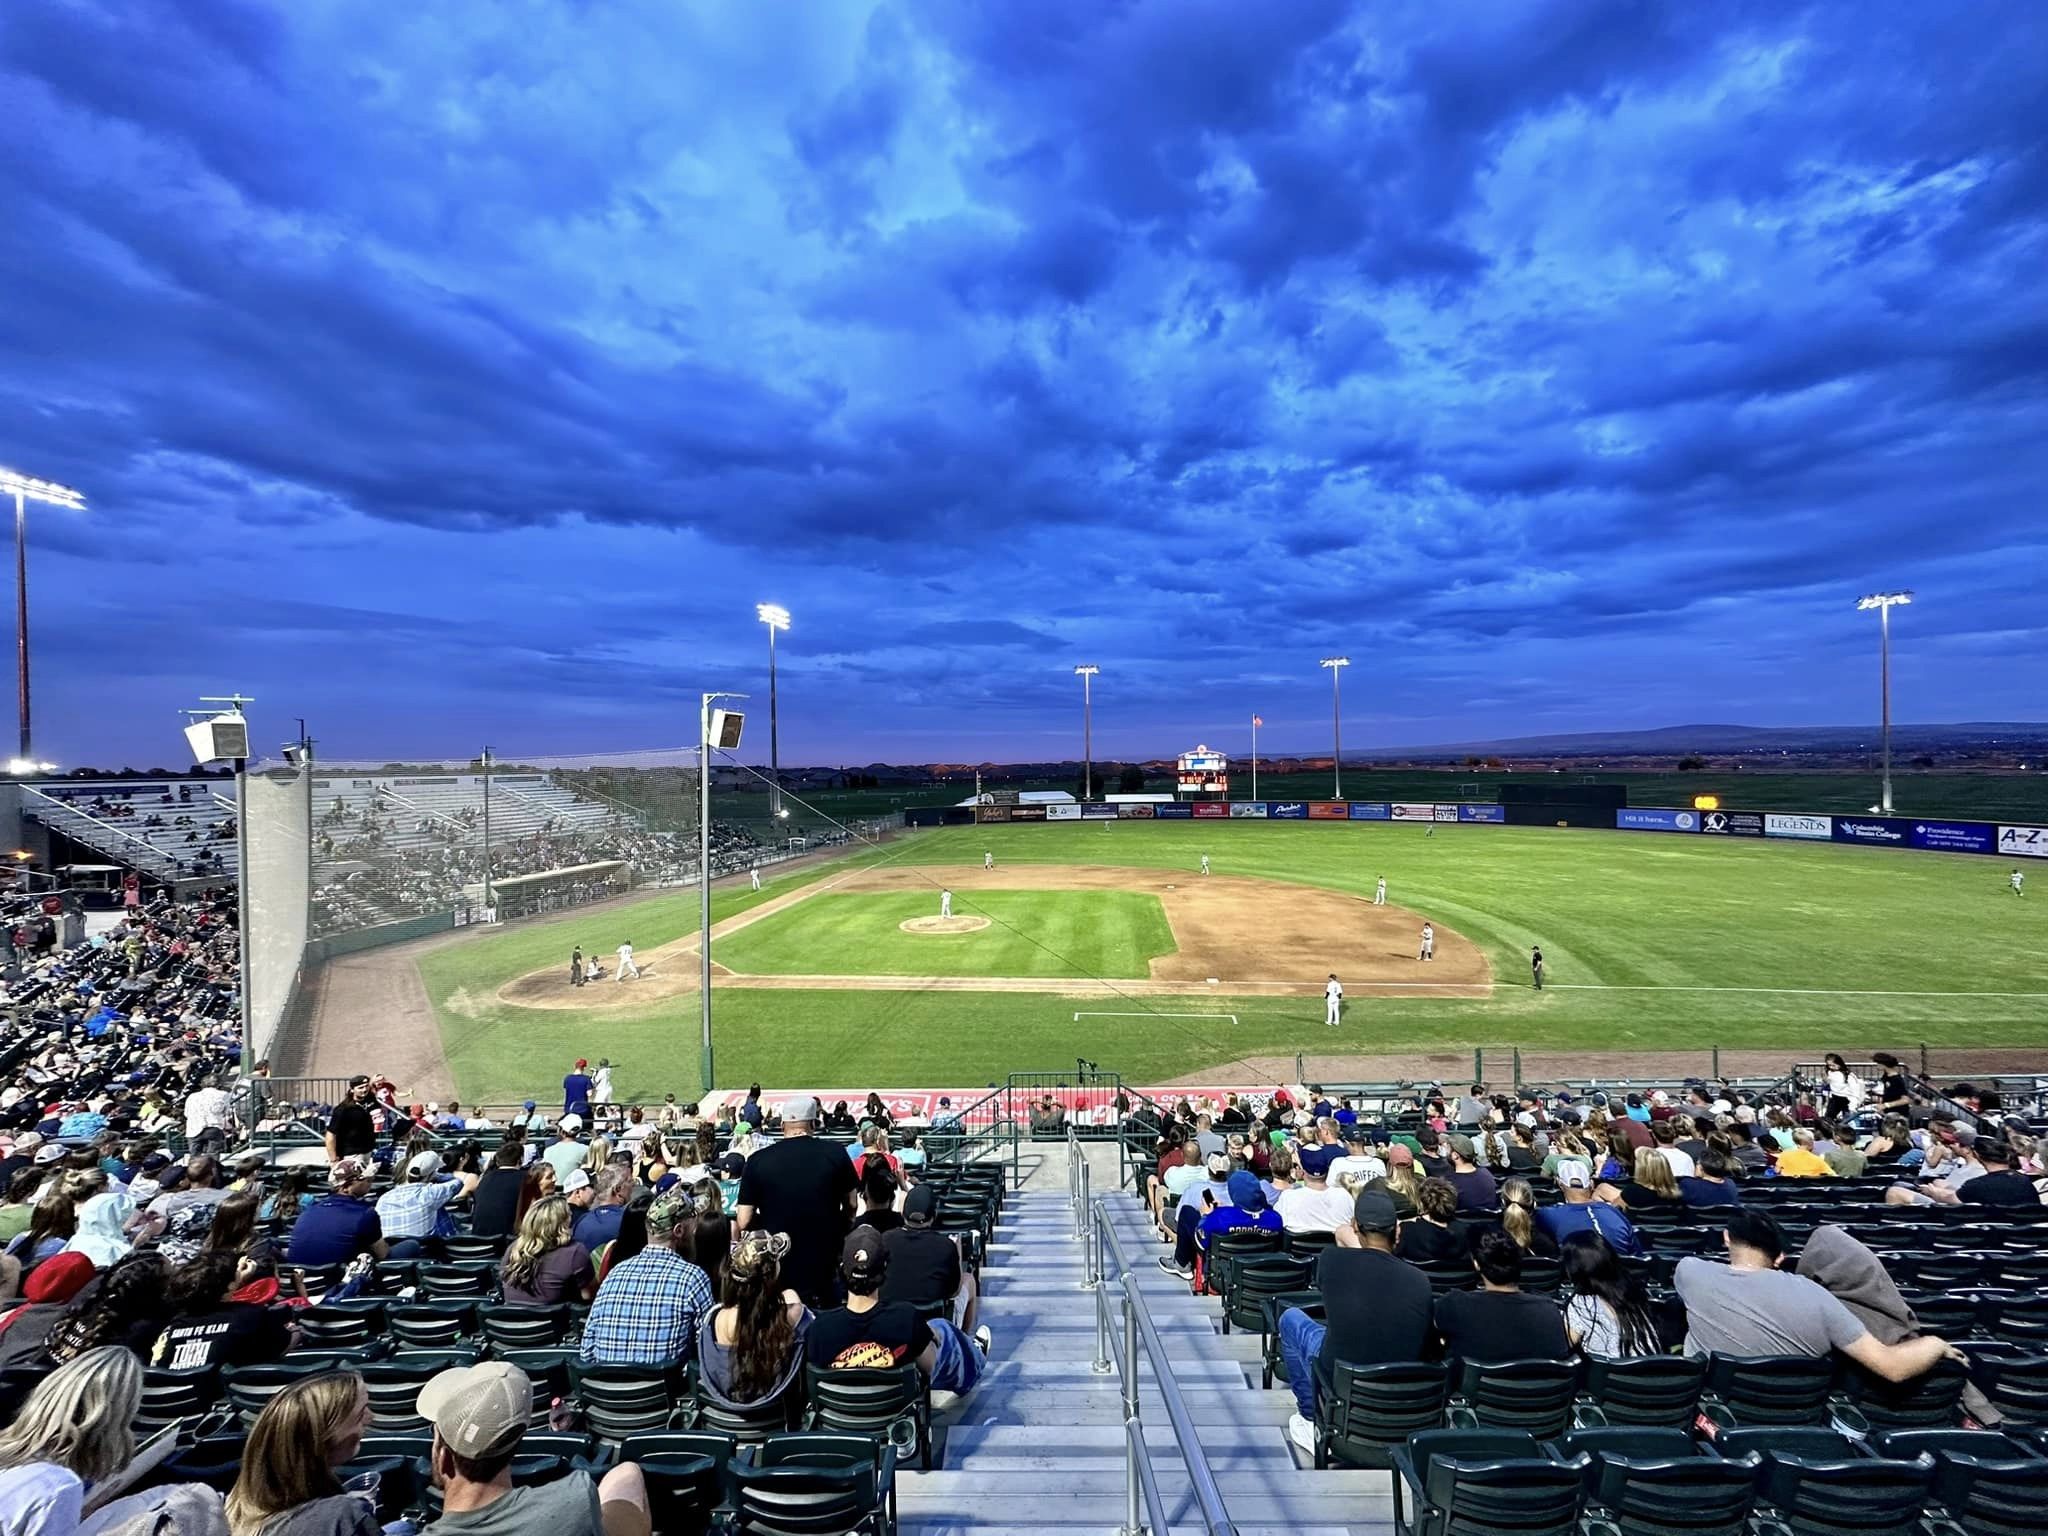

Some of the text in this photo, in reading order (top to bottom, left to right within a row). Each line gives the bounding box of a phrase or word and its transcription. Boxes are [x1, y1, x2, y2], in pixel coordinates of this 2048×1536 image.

[1771, 818, 1827, 831] LEGENDS
[1852, 824, 1885, 832] Columbia
[1876, 831, 1902, 840] College
